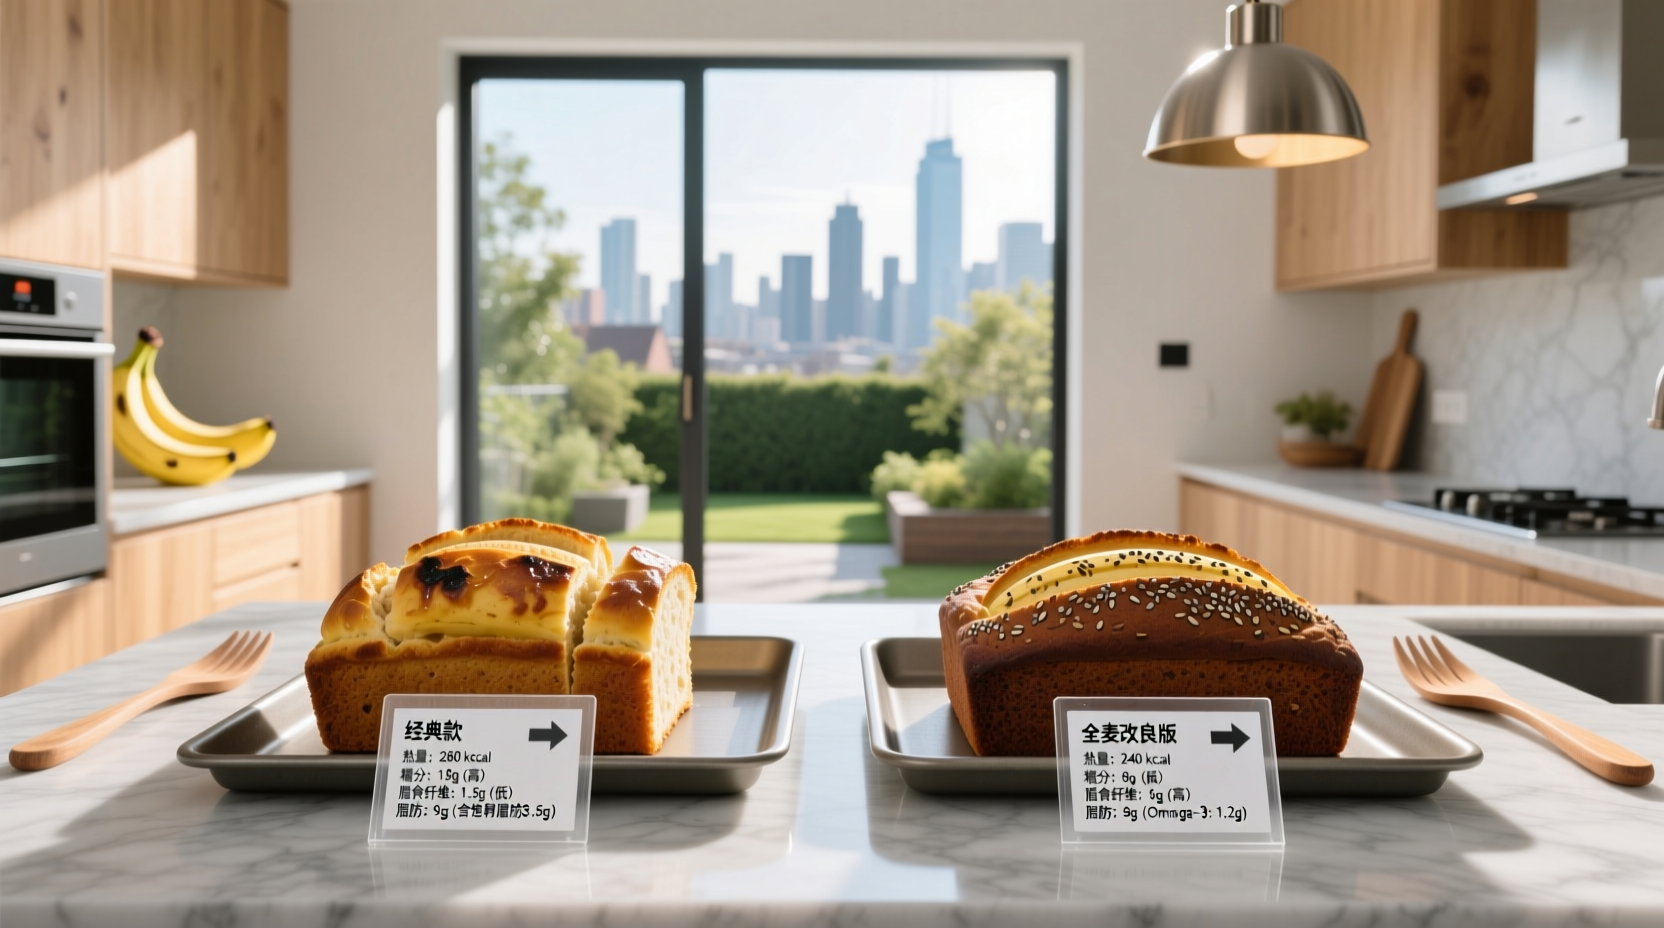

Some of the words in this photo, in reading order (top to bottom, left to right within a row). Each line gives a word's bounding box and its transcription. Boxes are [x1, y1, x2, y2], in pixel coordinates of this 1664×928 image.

[404, 720, 463, 741] 经典款
[1082, 722, 1178, 744] 全麦改良版
[1121, 753, 1142, 764] 240
[462, 787, 485, 801] 1.5g
[433, 805, 449, 820] 9g
[1216, 806, 1247, 822] 1.2g)
